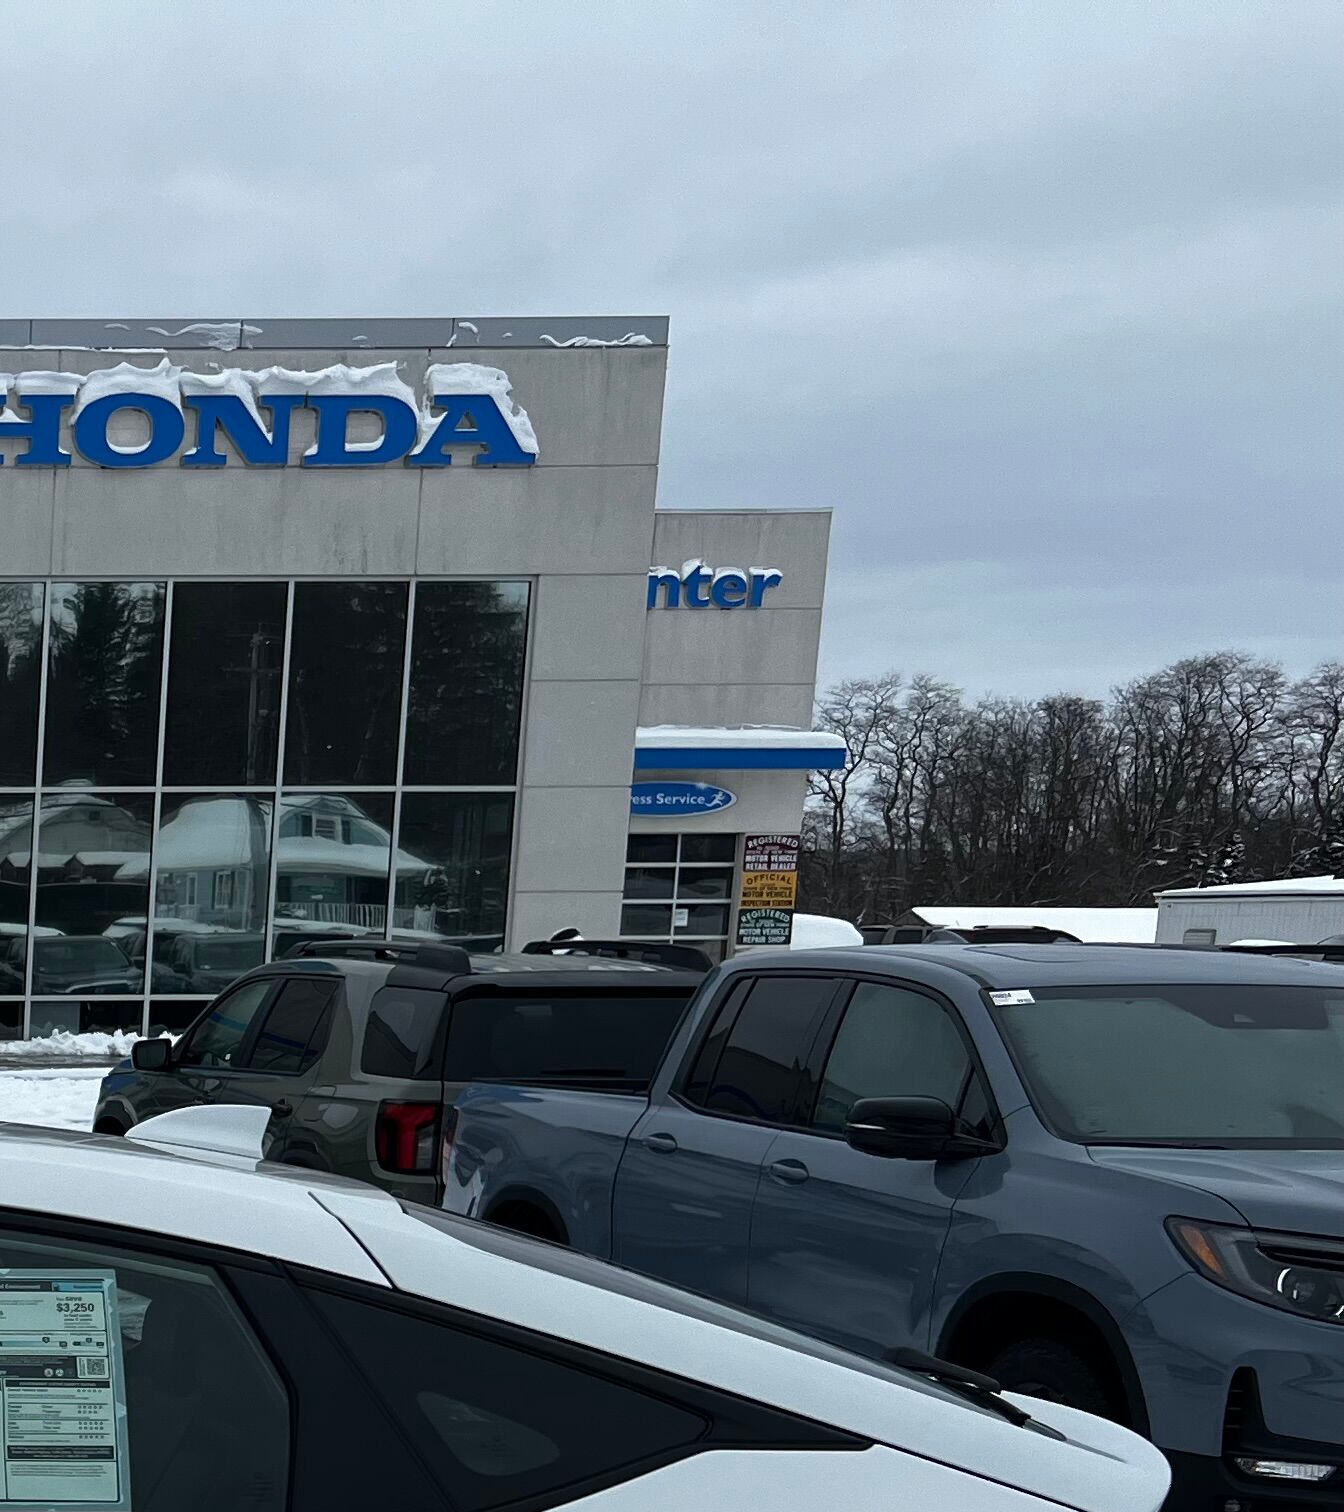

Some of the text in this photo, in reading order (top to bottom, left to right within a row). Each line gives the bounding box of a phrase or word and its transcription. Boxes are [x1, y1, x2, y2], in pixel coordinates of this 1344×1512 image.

[646, 565, 783, 608] nter
[631, 792, 706, 805] ess Service
[747, 835, 798, 848] REGISTERED
[746, 874, 792, 885] OFFICIAL
[56, 1303, 95, 1313] $3,250
